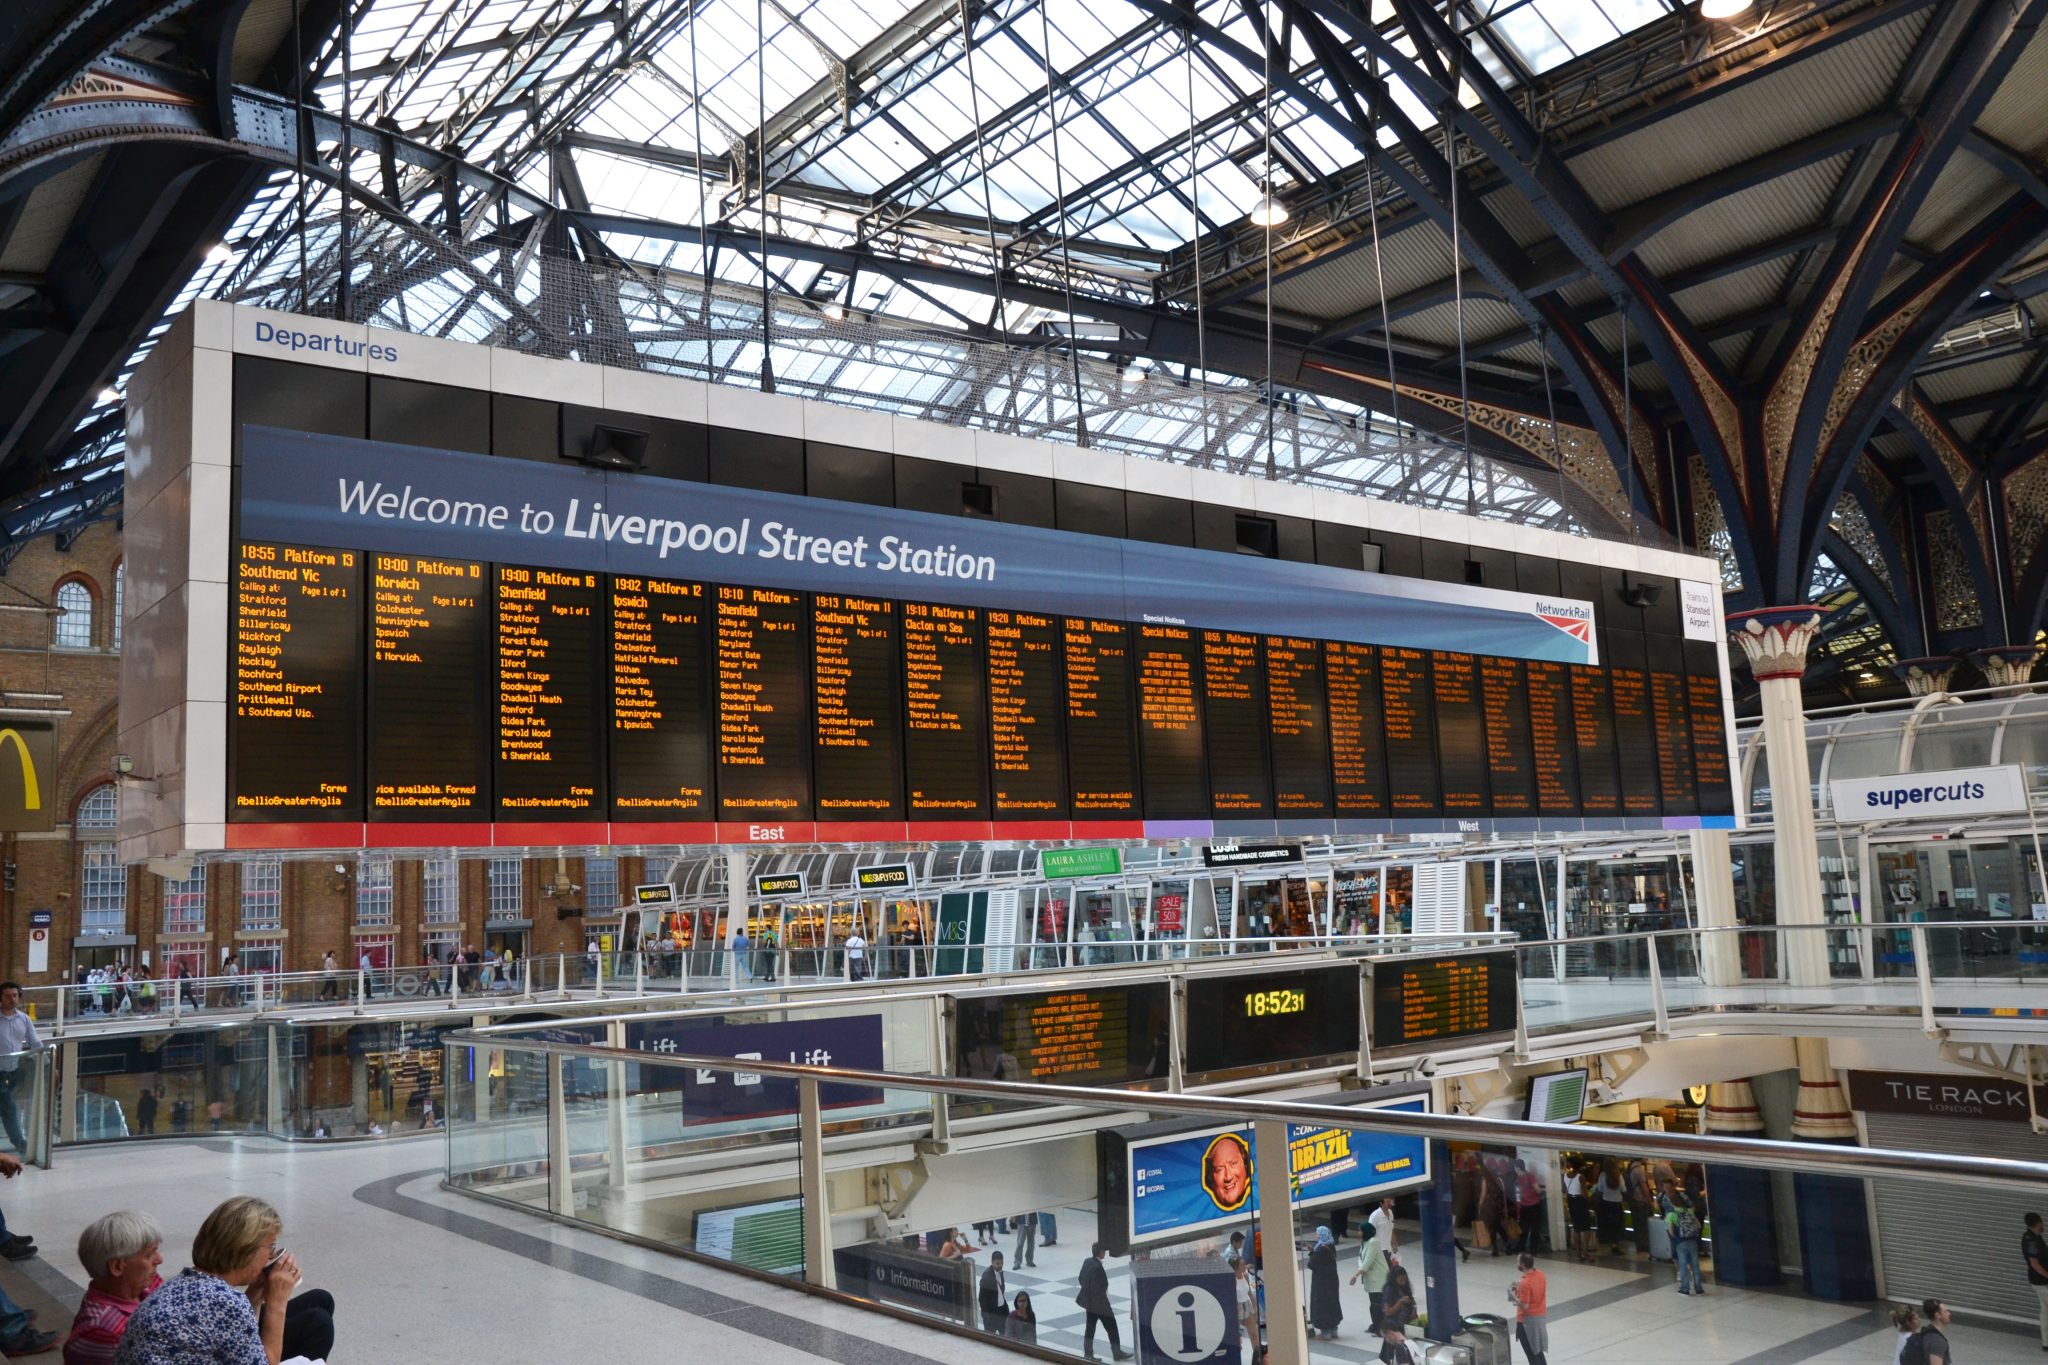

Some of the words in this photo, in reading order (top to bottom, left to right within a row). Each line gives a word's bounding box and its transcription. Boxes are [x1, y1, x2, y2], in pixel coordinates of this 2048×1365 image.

[255, 320, 399, 362] Departures
[338, 477, 509, 531] Welcome
[521, 500, 557, 535] to
[565, 498, 749, 558] Liverpool
[759, 520, 868, 570] Street
[879, 535, 997, 582] Station
[241, 545, 277, 561] 18:55
[283, 548, 337, 566] Platform
[341, 552, 355, 567] 13
[239, 563, 299, 581] Southend
[302, 567, 320, 583] Vic
[377, 556, 410, 573] 19:00
[416, 560, 465, 577] Platform
[469, 564, 481, 579] 10
[375, 574, 421, 591] Norwich
[501, 568, 530, 583] 19:00
[537, 571, 581, 587] Platform
[585, 575, 596, 588] 16
[239, 581, 267, 594] Calling
[301, 585, 321, 597] Page
[329, 587, 340, 597] of
[499, 585, 547, 601] Shenfield
[615, 578, 642, 592] 19:02
[648, 580, 689, 596] Platform
[693, 584, 702, 597] 12
[239, 593, 287, 605] Stratford
[375, 591, 401, 604] Calling
[613, 594, 649, 608] Ipswich
[719, 587, 745, 601] 19:10
[752, 589, 791, 604] Platform
[375, 603, 425, 615] Colchester
[718, 603, 759, 617] Shenfield
[816, 595, 840, 609] 19:13
[845, 598, 881, 613] Platform
[883, 602, 891, 613] 11
[1536, 601, 1590, 619] NetworkRail
[1686, 603, 1711, 616] Stansted
[239, 605, 287, 618] Shenfield
[375, 615, 431, 629] Manningtree
[500, 613, 540, 624] Stratford
[815, 610, 855, 626] Southend
[855, 614, 869, 626] Vic
[1143, 613, 1164, 623] Special
[1164, 616, 1186, 625] Notices
[1689, 616, 1710, 629] Airport
[239, 618, 292, 633] Billericay
[500, 624, 537, 636] Maryland
[614, 620, 652, 631] Stratford
[239, 631, 283, 643] Wickford
[375, 626, 410, 638] Ipswich
[614, 631, 652, 642] Shenfield
[375, 638, 397, 649] Diss
[499, 635, 528, 646] Forest
[530, 637, 550, 647] Gate
[238, 643, 283, 657] Rayleigh
[500, 647, 525, 657] Manor
[527, 648, 546, 657] Park
[238, 655, 277, 669] Hockley
[384, 651, 421, 662] Norwich.
[614, 653, 648, 664] Hatfield
[648, 655, 679, 666] Peverel
[501, 658, 527, 668] Ilford
[238, 668, 284, 680] Rochford
[501, 670, 525, 680] Seven
[527, 671, 551, 683] Kings
[615, 676, 650, 685] Kelvedon
[238, 681, 284, 692] Southend
[285, 683, 323, 695] Airport
[615, 687, 638, 696] Marks
[639, 688, 654, 699] Tey
[238, 694, 294, 705] Prittlewell
[501, 693, 538, 703] Chadwell
[539, 694, 563, 704] Heath
[615, 698, 657, 708] Colchester
[248, 707, 293, 718] Southend
[295, 708, 313, 718] Vic.
[615, 709, 663, 720] Manningtree
[501, 716, 525, 726] Gidea
[526, 717, 546, 726] Park
[623, 721, 654, 729] Ipswich.
[501, 728, 530, 737] Harold
[531, 729, 552, 738] Wood
[501, 739, 544, 749] Brentwood
[510, 751, 551, 761] Shenfield.
[397, 784, 443, 794] available.
[1866, 780, 1985, 810] supercuts
[237, 795, 342, 807] AbellioGreaterAnglia
[375, 796, 471, 808] AbellioGreaterAnglia
[502, 797, 589, 808] AbellioGreaterAnglia
[616, 797, 699, 808] AbellioGreaterAnglia
[1458, 819, 1480, 833] West
[749, 825, 785, 840] East
[1046, 855, 1075, 866] LAURA
[1077, 851, 1111, 864] ASHLEY
[1229, 852, 1258, 860] HANDMADE
[1258, 849, 1289, 858] COSMETICS
[1161, 896, 1180, 908] SALE
[938, 920, 967, 941] M&S
[1886, 1081, 1932, 1101] TIE
[1941, 1086, 2026, 1108] RACK
[1929, 1102, 1982, 1116] LONDON
[890, 1272, 945, 1297] Information
